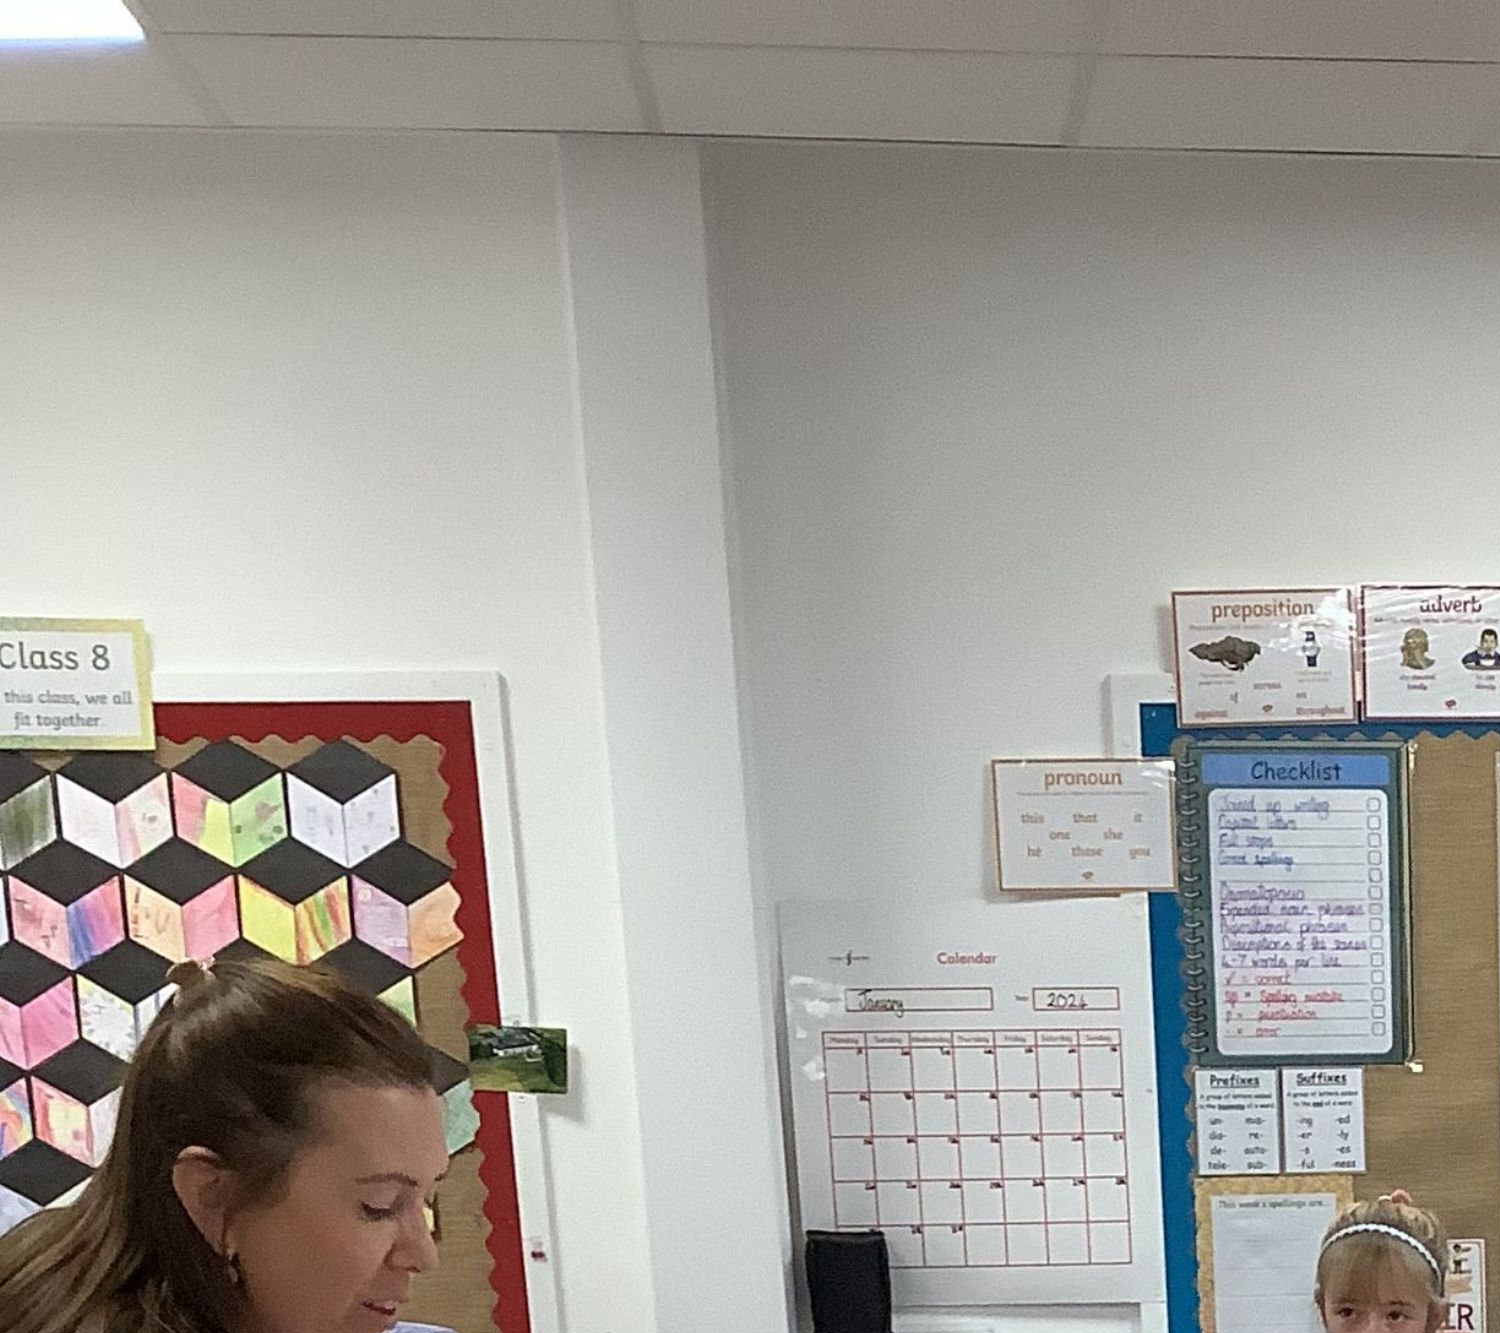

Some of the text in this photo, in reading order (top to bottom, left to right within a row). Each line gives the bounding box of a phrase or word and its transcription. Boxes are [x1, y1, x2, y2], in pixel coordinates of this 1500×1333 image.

[1211, 597, 1314, 623] preposition
[0, 640, 111, 671] Class 8
[4, 689, 133, 706] this class, we all
[1251, 760, 1343, 781] Checklist
[1044, 771, 1123, 791] pronoun
[1020, 811, 1046, 824] this
[936, 952, 998, 966] Calendar
[1210, 1073, 1261, 1089] Prefixes
[1296, 1071, 1347, 1088] Suffixes
